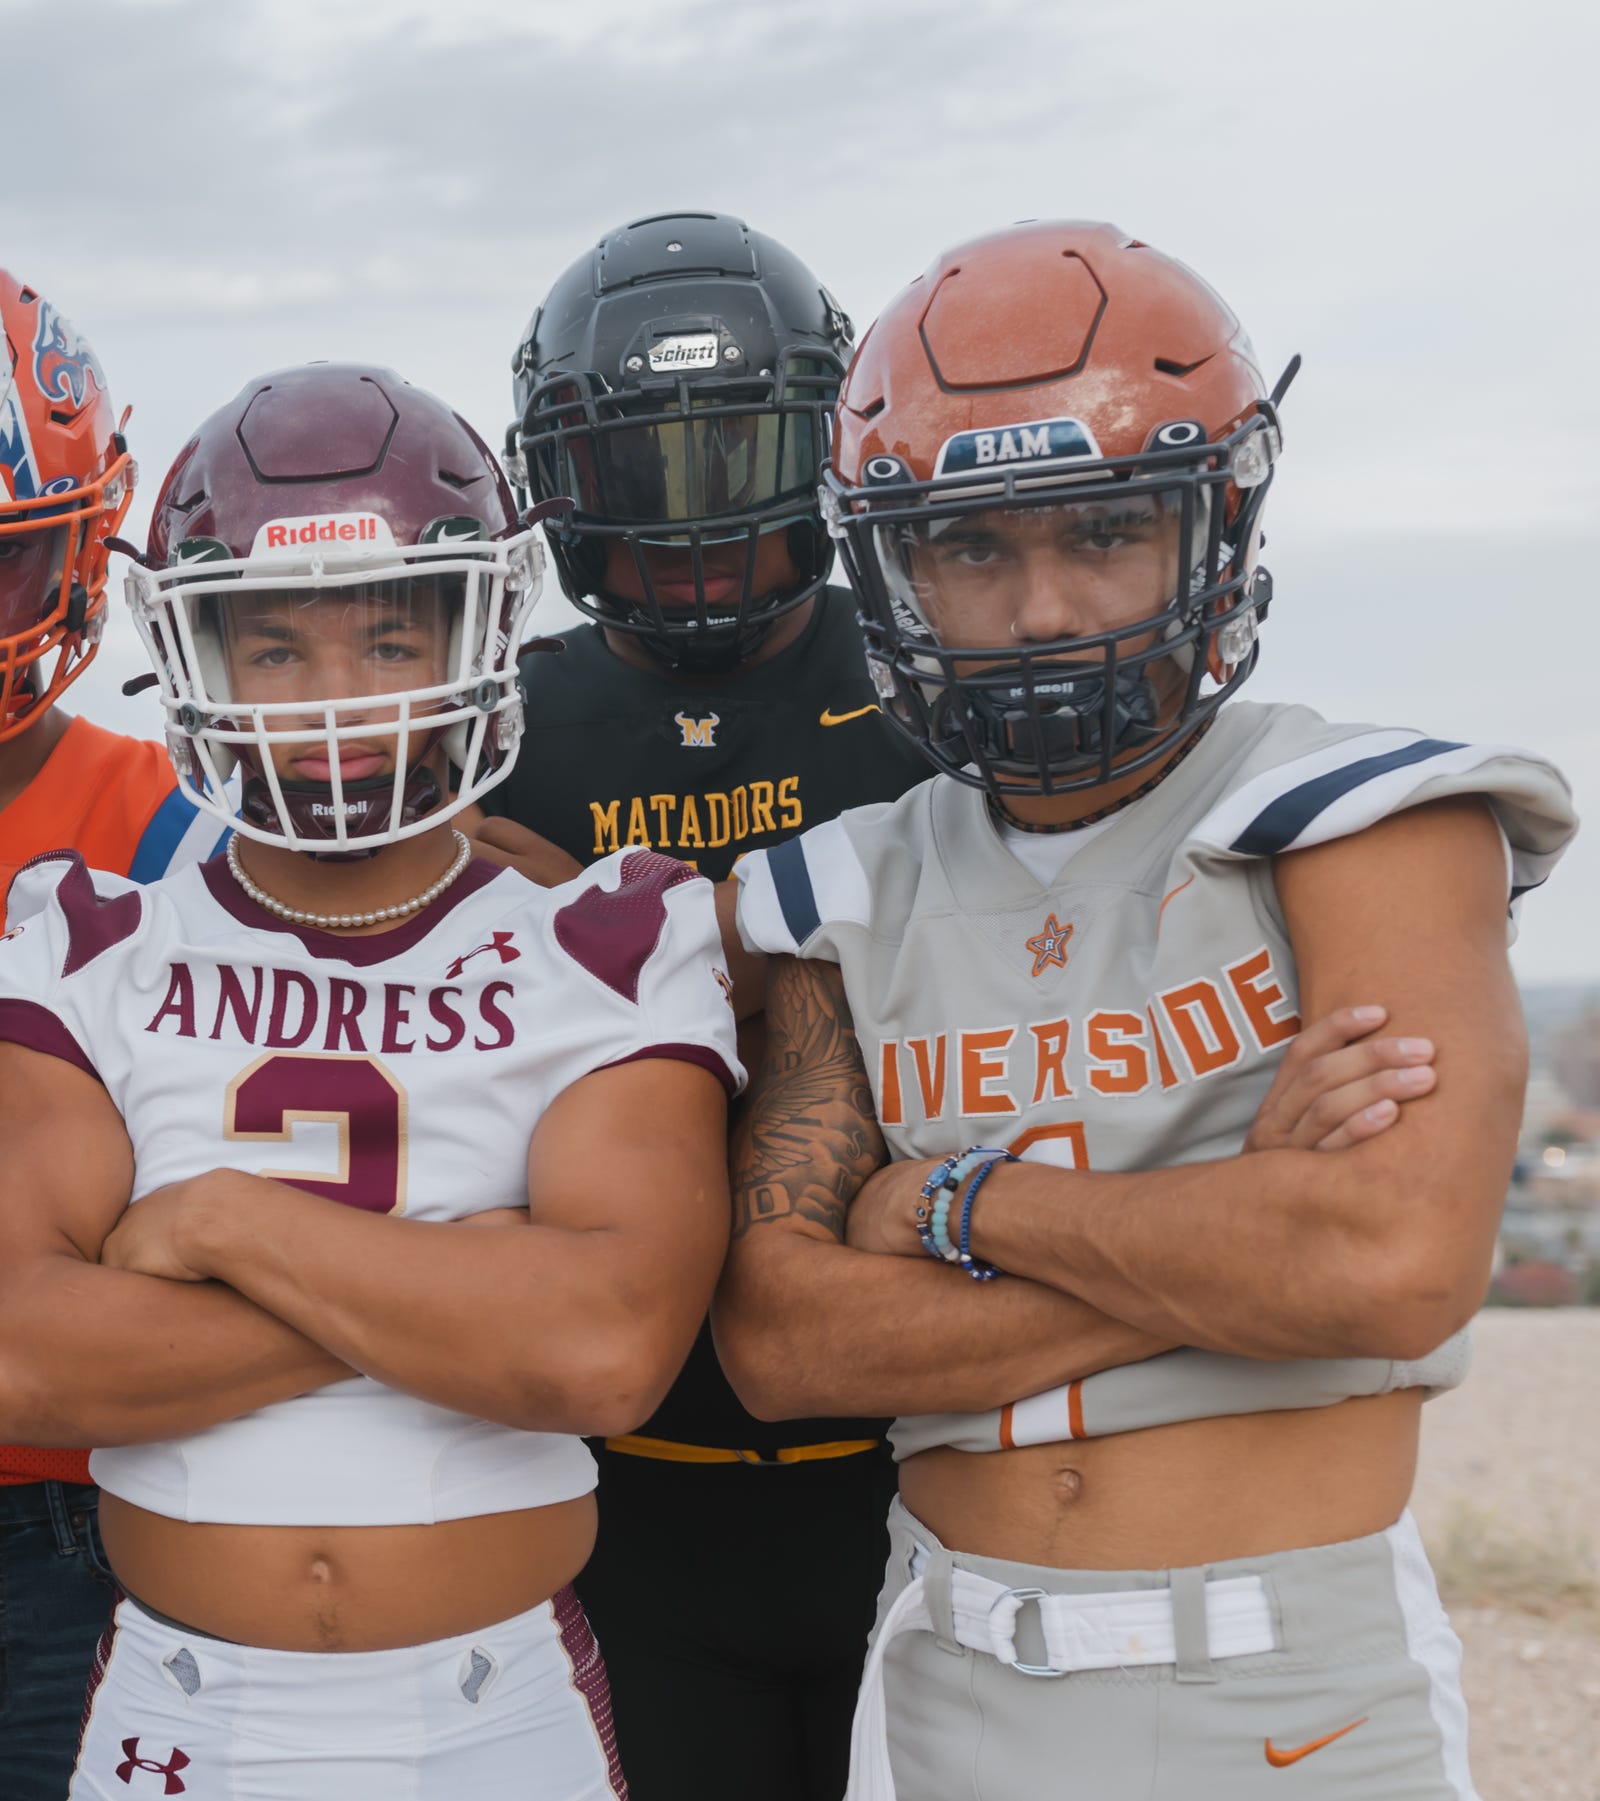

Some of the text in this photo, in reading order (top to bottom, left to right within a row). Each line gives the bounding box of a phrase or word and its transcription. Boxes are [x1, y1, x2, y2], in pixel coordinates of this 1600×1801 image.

[975, 425, 1052, 465] BAM
[266, 517, 377, 548] Riddell
[589, 775, 804, 855] MATADORS
[144, 962, 516, 1055] ANDRESS
